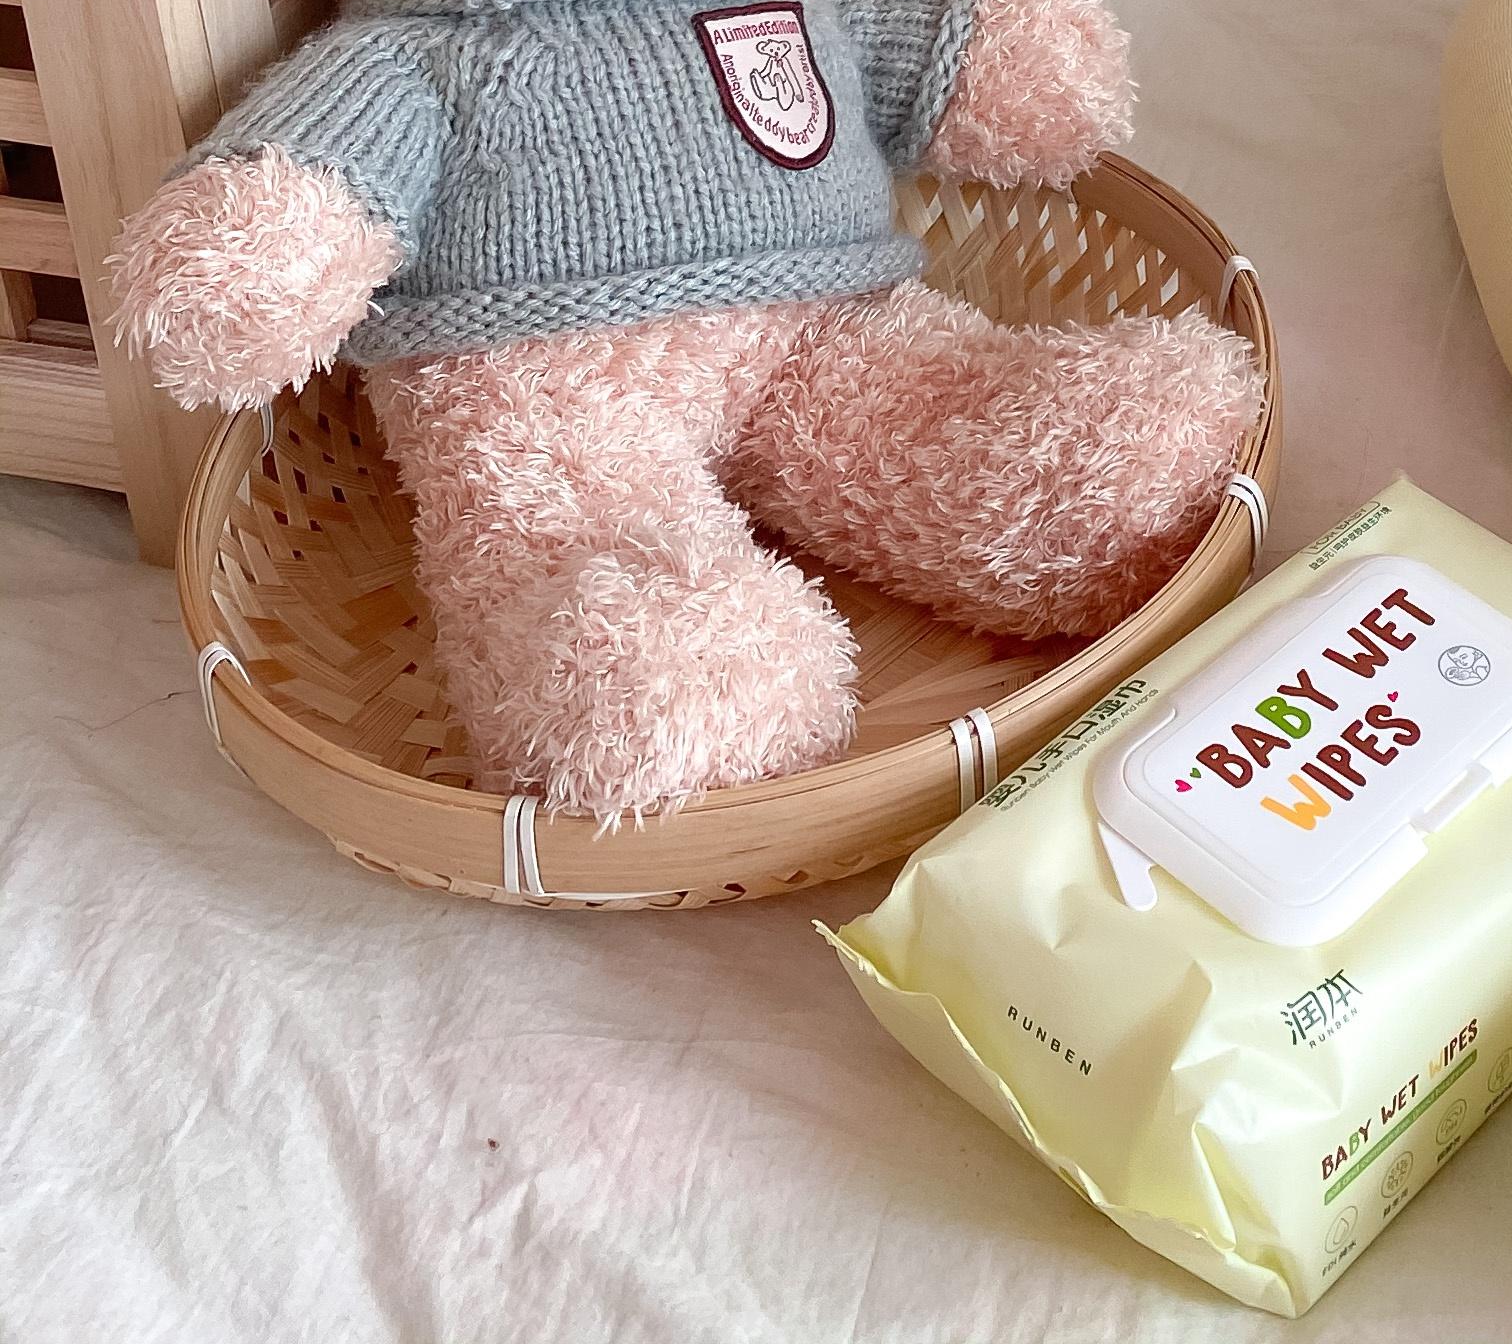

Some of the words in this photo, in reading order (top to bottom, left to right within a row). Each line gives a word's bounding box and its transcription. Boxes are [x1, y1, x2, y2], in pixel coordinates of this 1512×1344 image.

[978, 679, 1147, 807] 婴儿手口湿巾
[1196, 669, 1339, 789] BABY
[1322, 588, 1435, 679] WET
[1260, 704, 1421, 830] WIPES
[1007, 1004, 1092, 1076] RUNBEN
[1279, 968, 1364, 1047] 润本
[1309, 1007, 1359, 1049] RUNBEN
[1321, 1118, 1372, 1181] BABY
[1380, 1073, 1420, 1126] WET
[1428, 1017, 1478, 1079] WIPES
